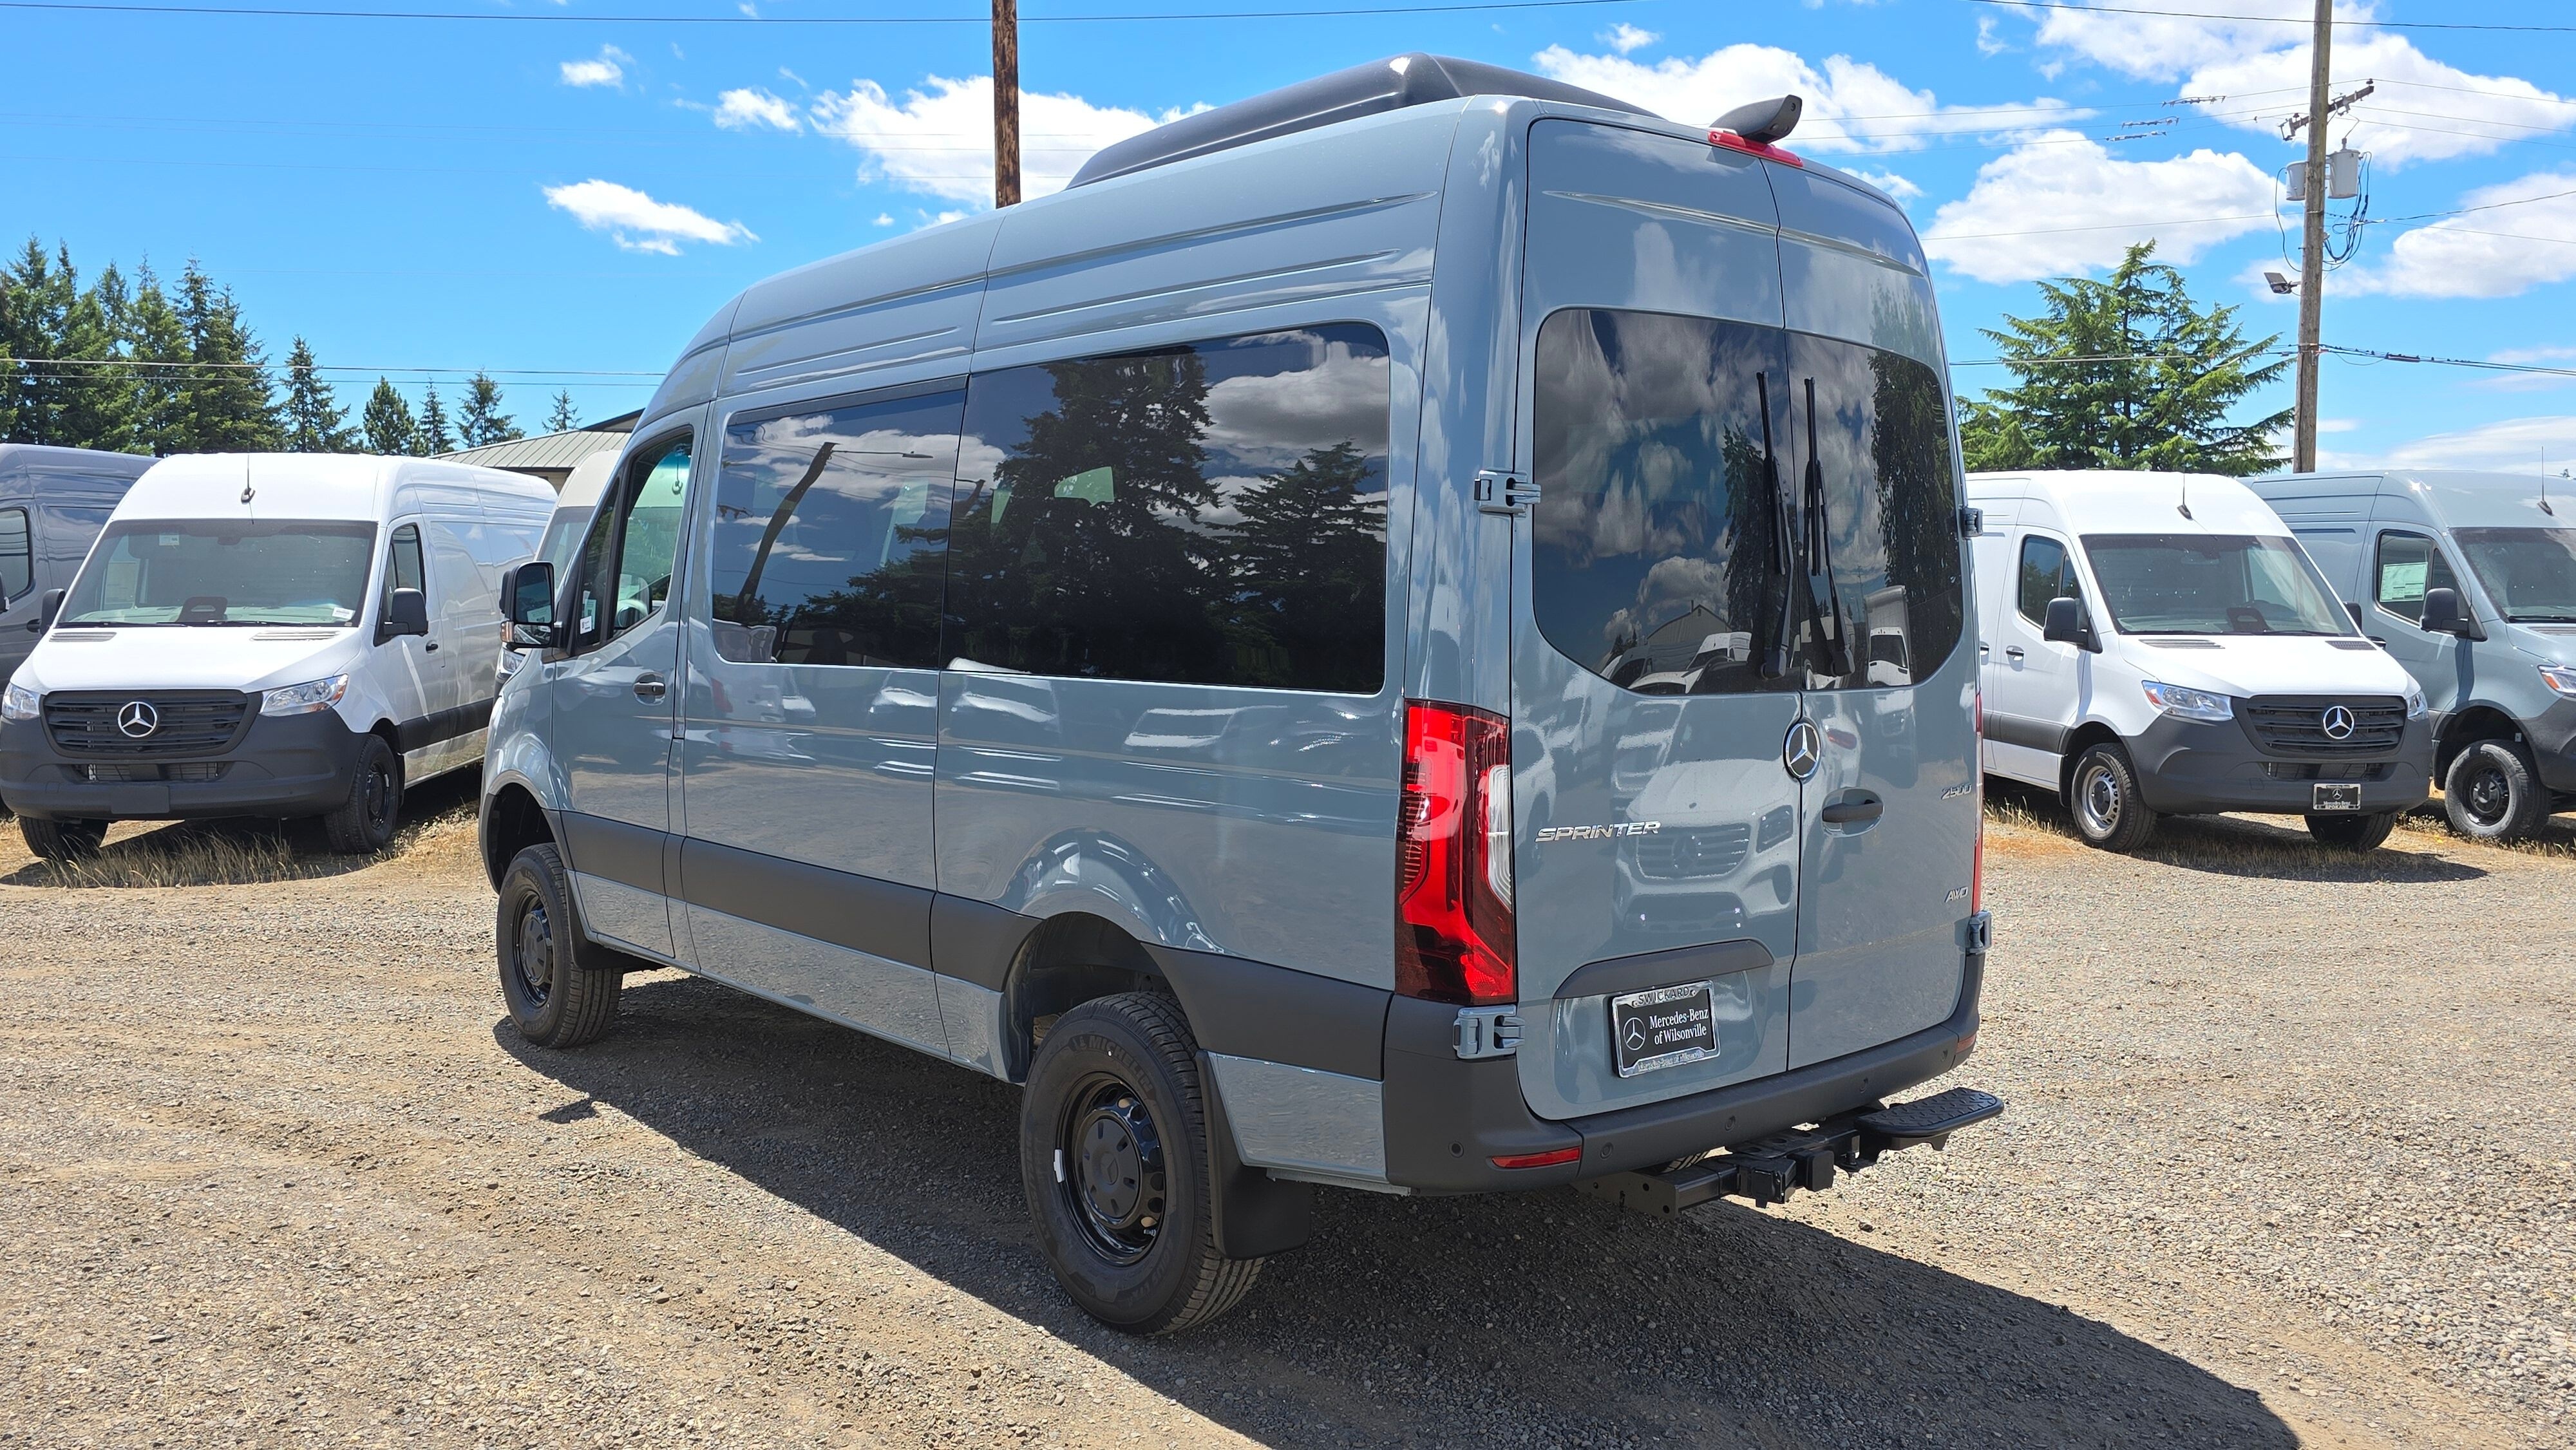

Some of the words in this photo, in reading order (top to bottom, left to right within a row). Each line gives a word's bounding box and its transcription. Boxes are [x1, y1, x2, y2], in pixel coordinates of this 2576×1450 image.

[1941, 783, 1971, 800] 2500
[1535, 820, 1662, 842] SPRINTER
[1944, 887, 1968, 903] AWD
[1638, 986, 1690, 1005] SWICKARD
[1649, 1008, 1709, 1030] Mercedes-Benz
[1654, 1031, 1664, 1045] of
[1663, 1023, 1707, 1043] Wilsonville
[1088, 1035, 1155, 1093] MICHELIN
